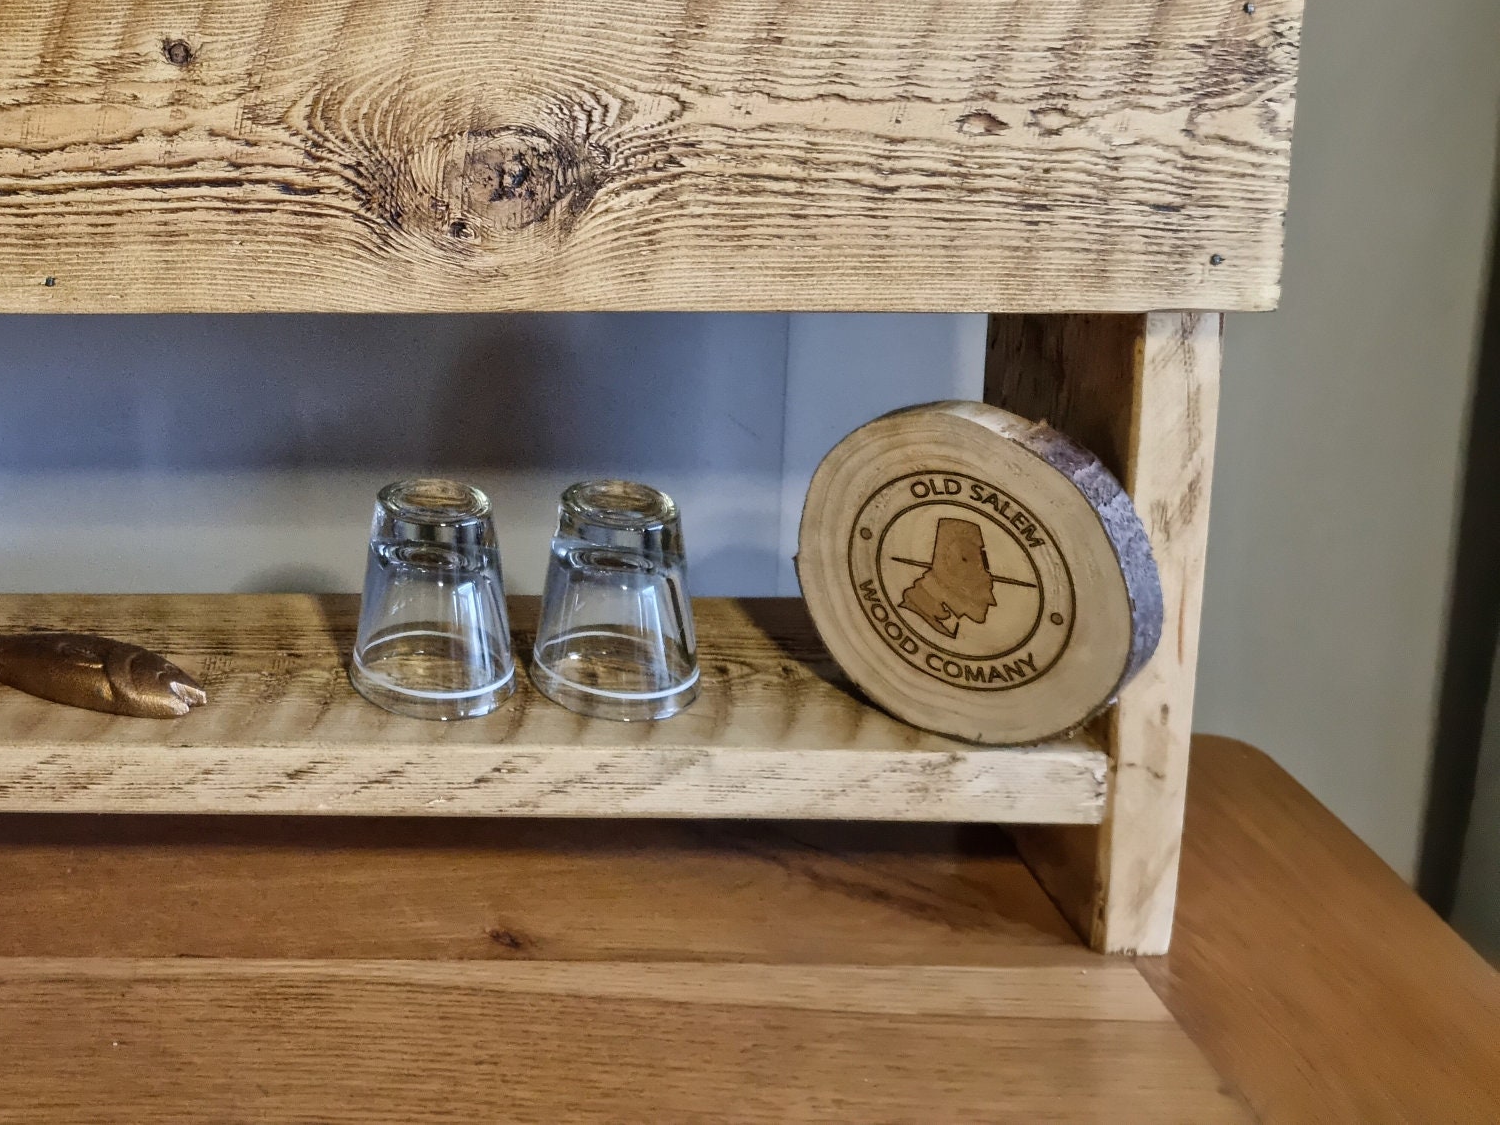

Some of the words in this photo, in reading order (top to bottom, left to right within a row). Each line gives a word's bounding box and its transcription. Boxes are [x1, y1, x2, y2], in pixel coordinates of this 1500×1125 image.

[910, 478, 962, 499] OLD
[969, 483, 1046, 549] SALEM
[859, 578, 919, 656] WOOD
[925, 652, 1038, 684] COMANY
